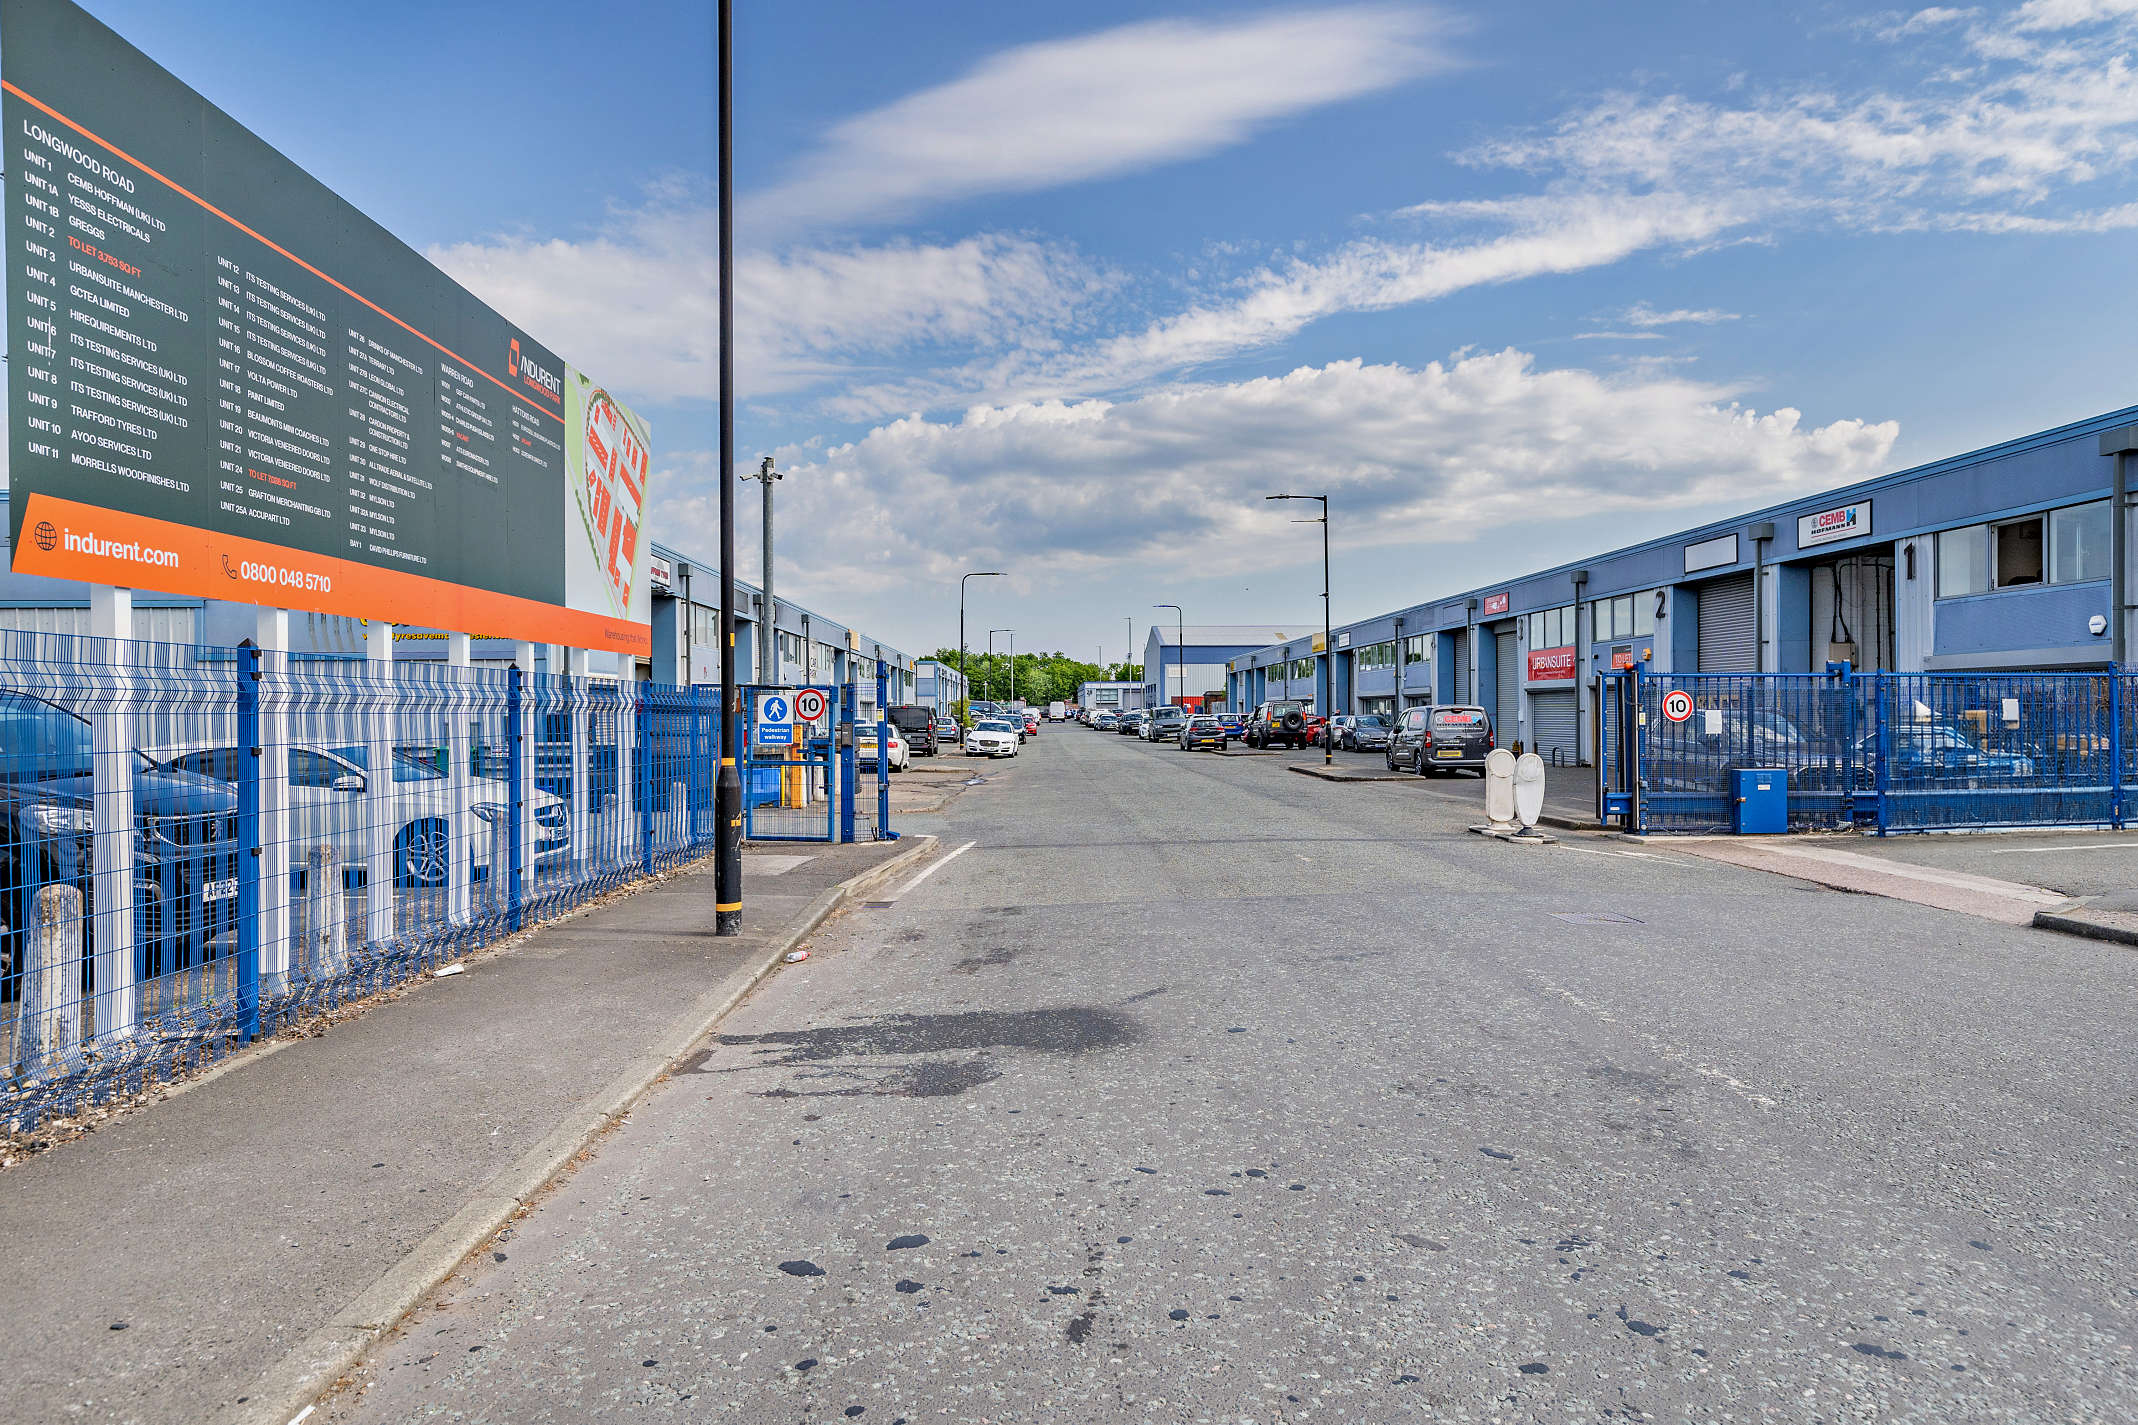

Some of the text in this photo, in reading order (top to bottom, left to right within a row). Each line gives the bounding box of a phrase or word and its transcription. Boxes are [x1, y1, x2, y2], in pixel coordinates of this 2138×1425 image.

[24, 120, 134, 194] LONGWOOD ROAD
[25, 149, 166, 232] UNIT 1 CEMB HOFFMAN (UK) LTD
[25, 171, 151, 243] UNIT 1A YESSS ELECTRICALS
[26, 193, 105, 240] UNIT 1B GREGGS
[26, 215, 142, 278] UNIT 2 TO LET 3,753 SQ FT
[26, 240, 189, 323] UNIT 3 URBANSUITE MANCHESTER LTD
[26, 265, 129, 318] UNIT 4 GCTEA LIMITED
[218, 256, 233, 271] UNIT
[246, 271, 255, 285] ITS
[256, 277, 280, 297] TESTING
[280, 289, 305, 311] SERVICES
[306, 303, 316, 316] (UK)
[316, 308, 326, 321] LTD
[27, 290, 157, 352] UNIT 5 HIREQUIREMENTS LTD
[28, 316, 187, 386] UNIT 6 ITS TESTING SERVICES (UK) LTD
[219, 338, 234, 352] UNIT
[247, 350, 275, 371] BLOSSOM
[276, 363, 297, 380] COFFEE
[297, 372, 324, 392] ROASTERS
[324, 383, 333, 396] LTD
[349, 328, 359, 340] UNIT
[390, 350, 415, 371] MANCHESTER
[28, 341, 187, 407] UNIT 7 ITS TESTING SERVICES (UK) LTD
[220, 358, 234, 371] UNIT
[248, 370, 266, 386] VOLTA
[267, 378, 287, 394] POWER
[288, 386, 297, 398] LTD
[220, 378, 234, 392] UNIT
[248, 390, 263, 404] PAINT
[264, 396, 285, 411] LIMITED
[441, 363, 460, 382] WARREN
[461, 374, 474, 388] ROAD
[521, 356, 560, 394] INDURENT
[524, 374, 549, 398] LONGWOOD
[28, 366, 188, 428] UNIT 8 ITS TESTING SERVICES (UK) LTD
[28, 391, 157, 440] UNIT 9 TRAFFORD TYRES LTD
[28, 416, 152, 460] UNIT 10 AYOO SERVICES LTD
[220, 399, 234, 412] UNIT
[248, 409, 282, 430] BEAUMONTS
[283, 422, 295, 435] MINI
[295, 426, 319, 443] COACHES
[320, 435, 329, 447] LTD
[220, 419, 234, 432] UNIT
[248, 429, 274, 446] VICTORIA
[274, 438, 302, 456] VENEERED
[303, 447, 320, 462] DOORS
[321, 453, 330, 465] LTD
[28, 442, 190, 493] UNIT 11 MORRELLS WOODFINISHES LTD
[220, 480, 235, 492] UNIT
[249, 488, 275, 504] GRAFTON
[276, 496, 314, 514] MERCHANTING
[314, 506, 322, 516] GB
[322, 508, 331, 519] LTD
[221, 501, 235, 513] UNIT
[249, 508, 279, 523] ACCUPART
[280, 515, 290, 526] LTD
[1819, 510, 1845, 527] CEMB
[64, 528, 179, 568] indurent.com
[1811, 523, 1845, 534] HOFMANN
[240, 561, 331, 593] 0800 048 5710
[1904, 542, 1913, 580] 1
[1656, 591, 1666, 618] 2
[1532, 654, 1571, 670] URBANSUITE
[1616, 654, 1631, 663] TO LET
[802, 698, 819, 712] 10
[1670, 700, 1686, 712] 10
